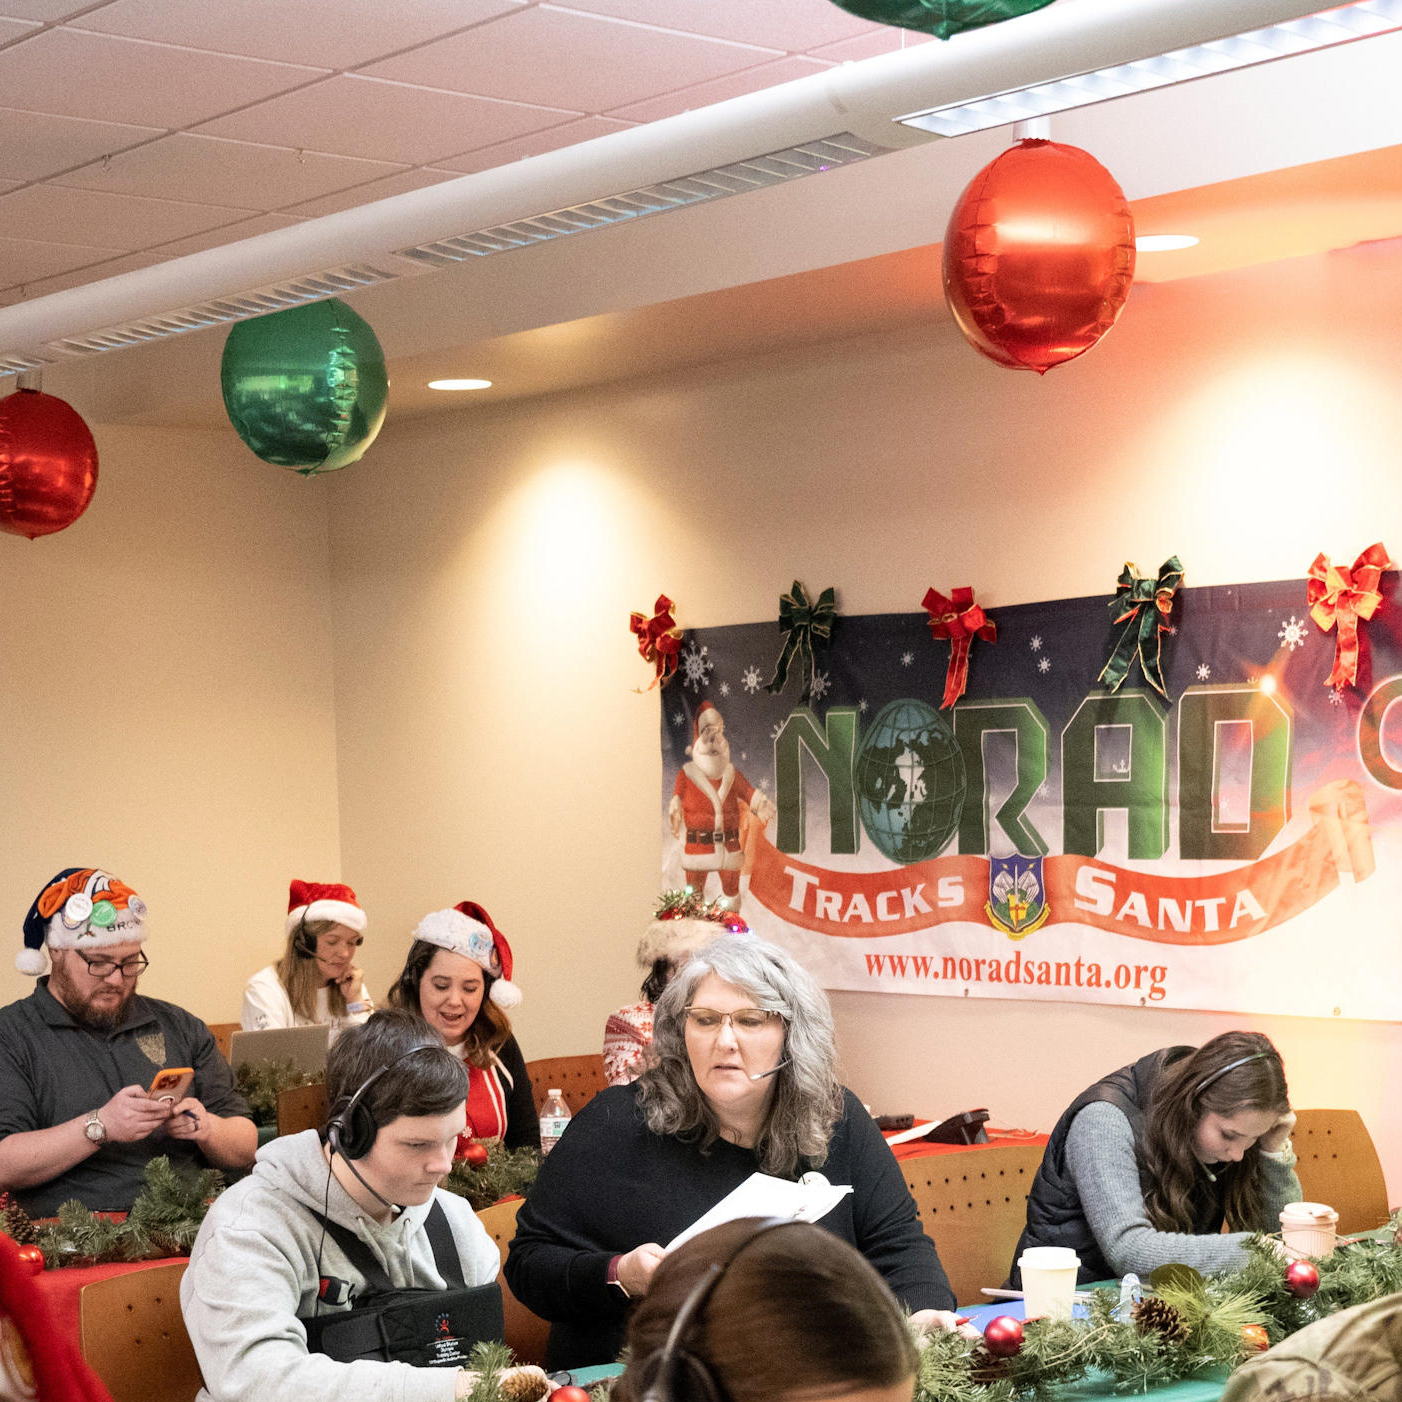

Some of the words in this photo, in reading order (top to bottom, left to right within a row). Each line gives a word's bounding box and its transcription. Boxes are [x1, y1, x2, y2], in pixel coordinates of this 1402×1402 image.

[774, 683, 1296, 863] NORAD
[781, 863, 966, 926] TRACKS
[1073, 862, 1268, 934] SANTA
[864, 949, 1169, 1001] www.noradsanta.org
